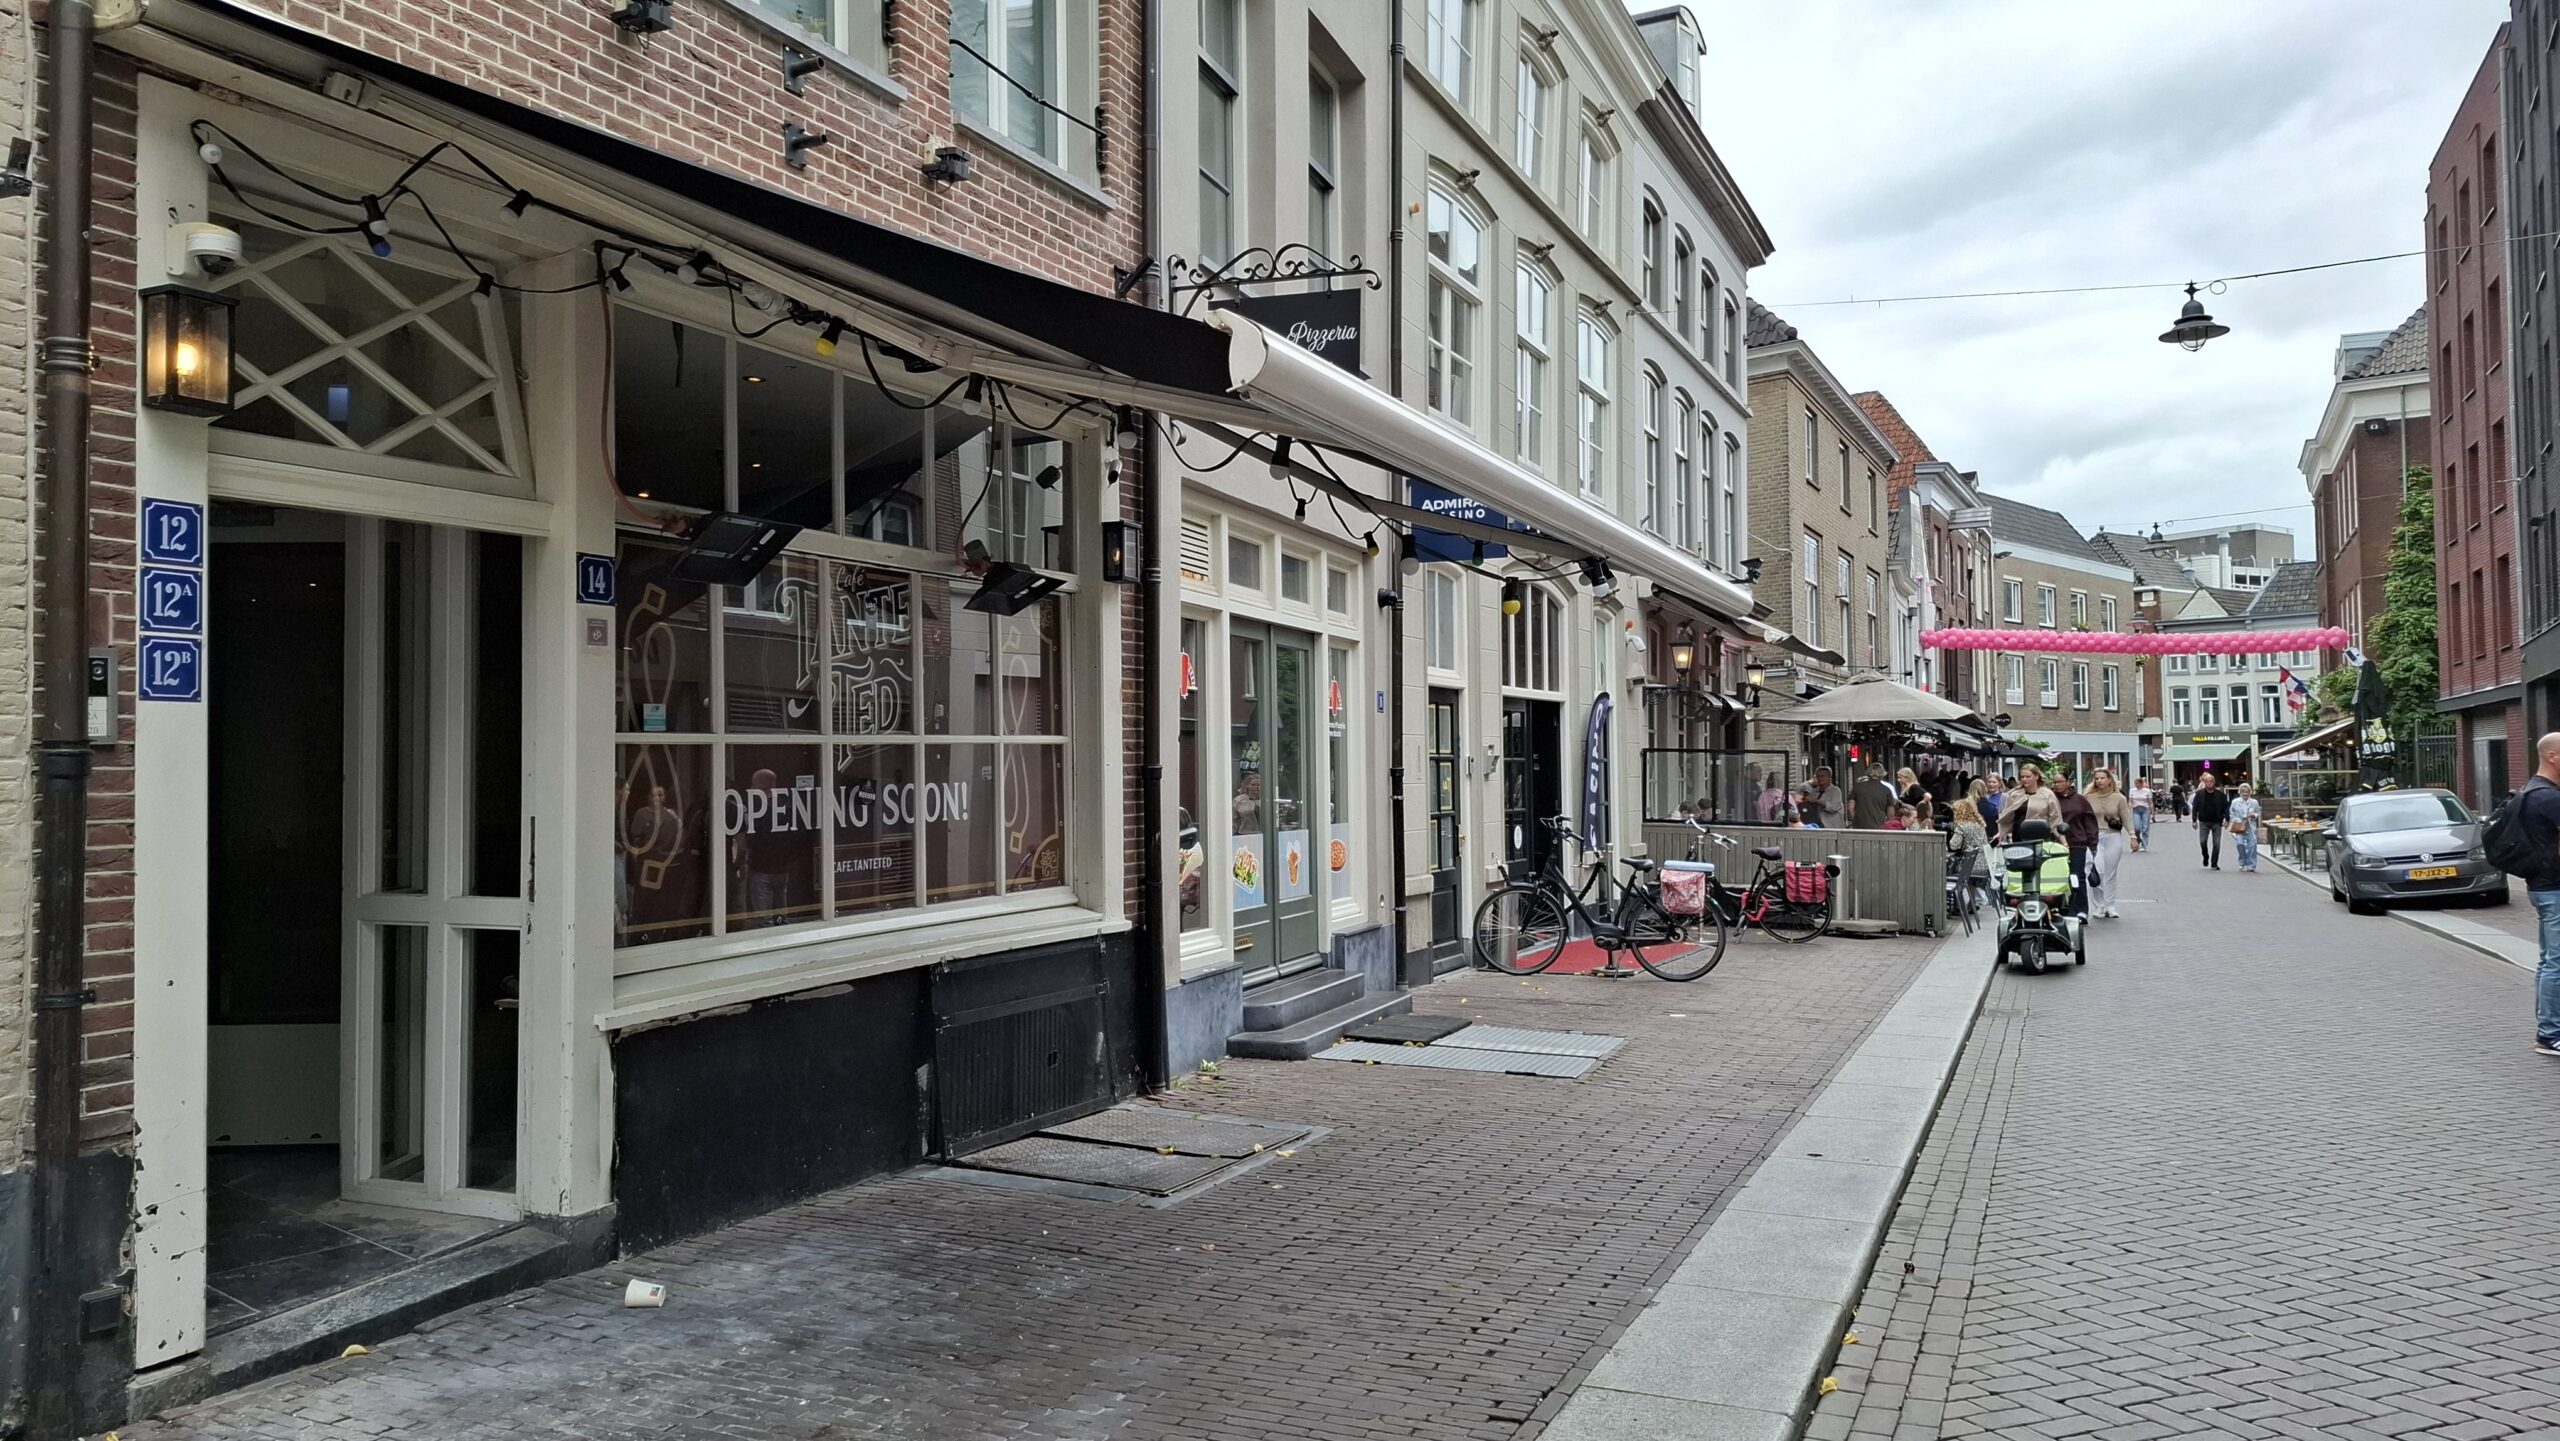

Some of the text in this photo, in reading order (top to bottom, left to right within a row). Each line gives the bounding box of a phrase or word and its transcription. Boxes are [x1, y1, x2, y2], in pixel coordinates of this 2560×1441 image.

[1286, 320, 1358, 352] Pizzeria
[1421, 497, 1488, 512] ADMIRA
[1441, 508, 1486, 519] SINO
[159, 514, 188, 551] 12
[588, 565, 606, 594] 14
[836, 565, 866, 592] Café
[773, 577, 912, 690] TANTE
[817, 656, 900, 772] TED
[724, 781, 969, 836] OPENING SOON!
